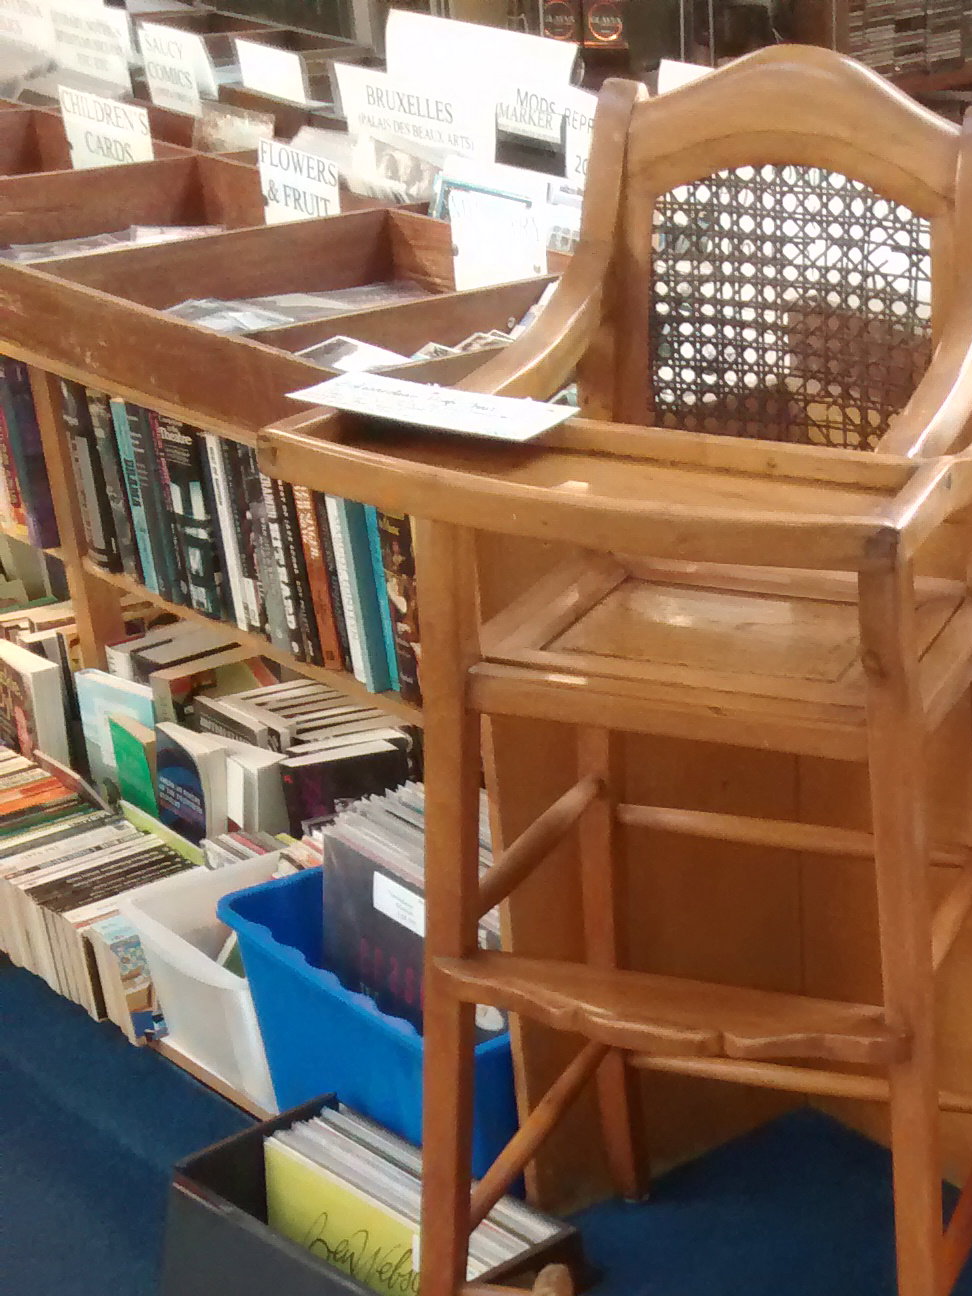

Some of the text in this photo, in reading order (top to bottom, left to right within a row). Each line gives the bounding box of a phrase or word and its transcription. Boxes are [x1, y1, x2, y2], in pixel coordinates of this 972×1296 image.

[147, 61, 194, 90] COMICS
[60, 91, 149, 137] CHILDREN'S
[365, 83, 454, 124] BRUXELLES
[499, 102, 554, 131] MARKER
[84, 130, 135, 163] CARDS
[261, 140, 338, 188] FLOWERS
[267, 179, 331, 217] & FRUIT
[123, 457, 143, 508] DRAMA
